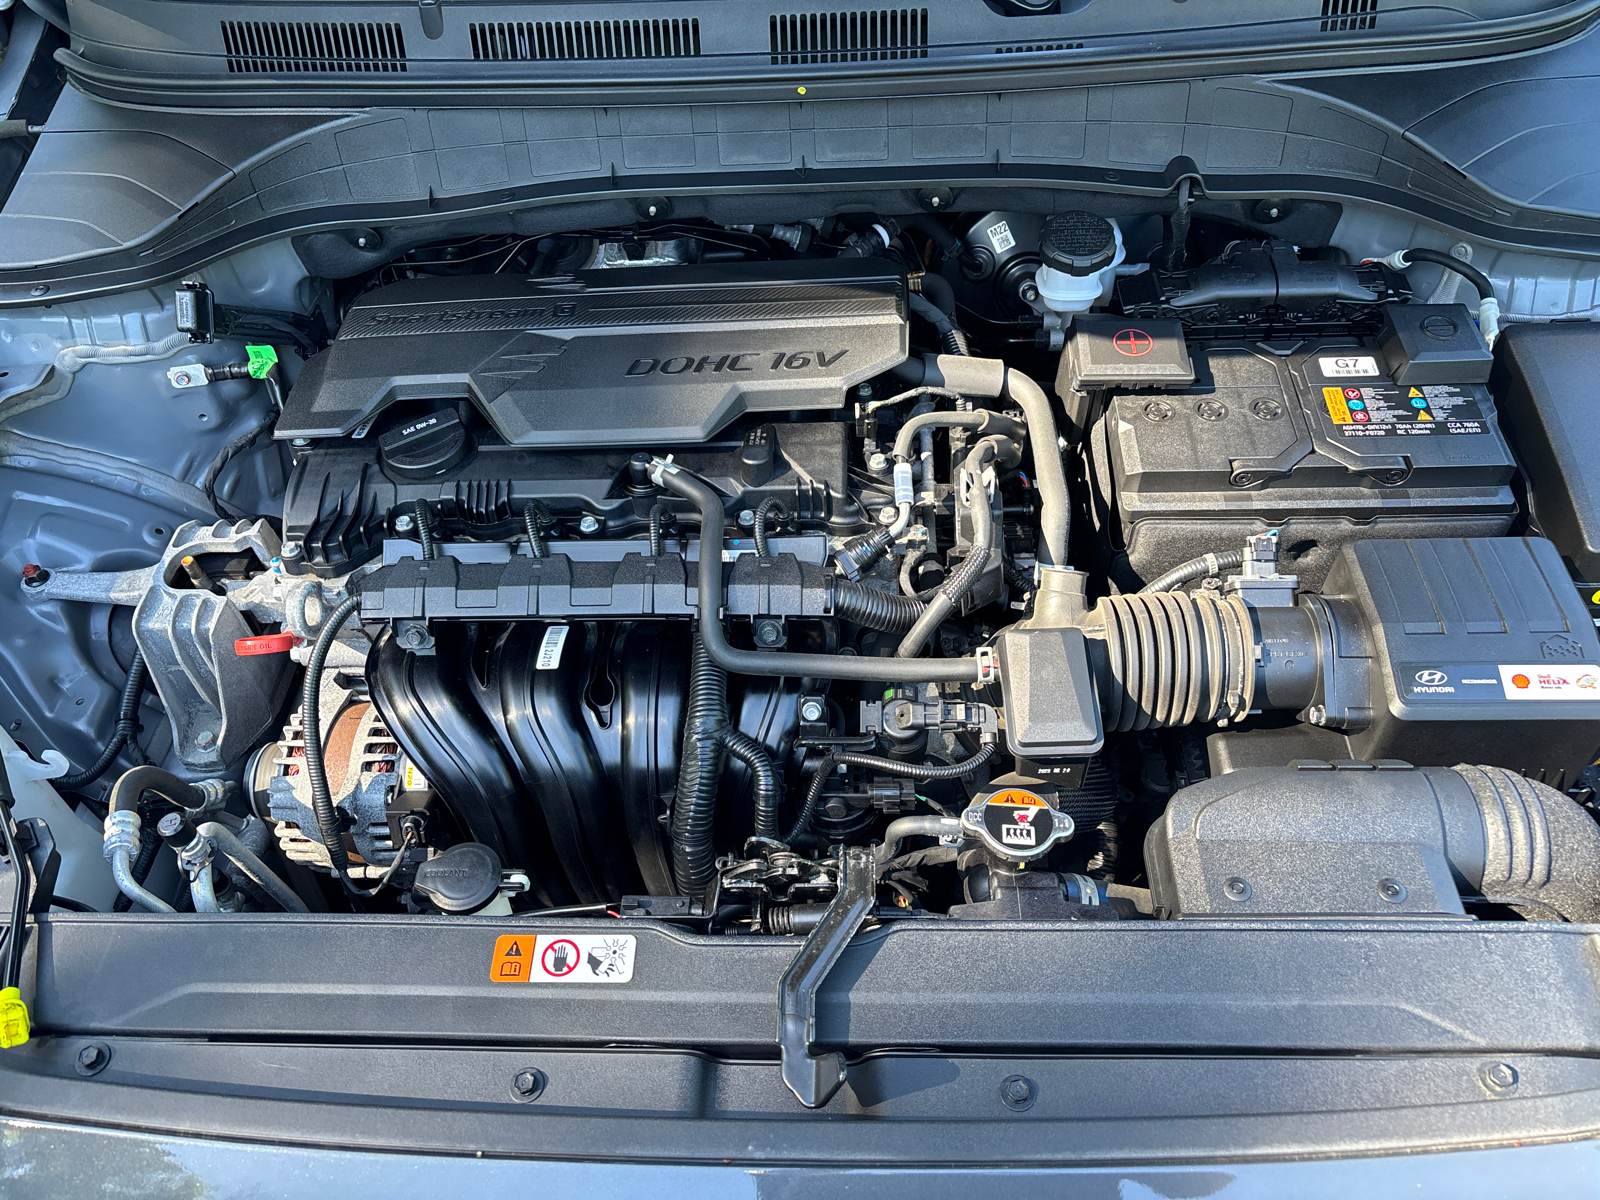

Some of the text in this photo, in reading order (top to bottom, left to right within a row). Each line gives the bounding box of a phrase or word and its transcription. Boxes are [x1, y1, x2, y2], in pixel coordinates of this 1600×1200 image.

[990, 222, 1009, 239] M22
[625, 349, 850, 378] DOHC 16V
[1335, 358, 1359, 368] G7
[402, 418, 437, 435] SAE 0W-20
[259, 642, 273, 650] OIL
[541, 649, 554, 667] 2J210
[1538, 677, 1570, 685] HELIX
[1054, 818, 1069, 828] 1.1
[425, 868, 469, 877] COOLANT
